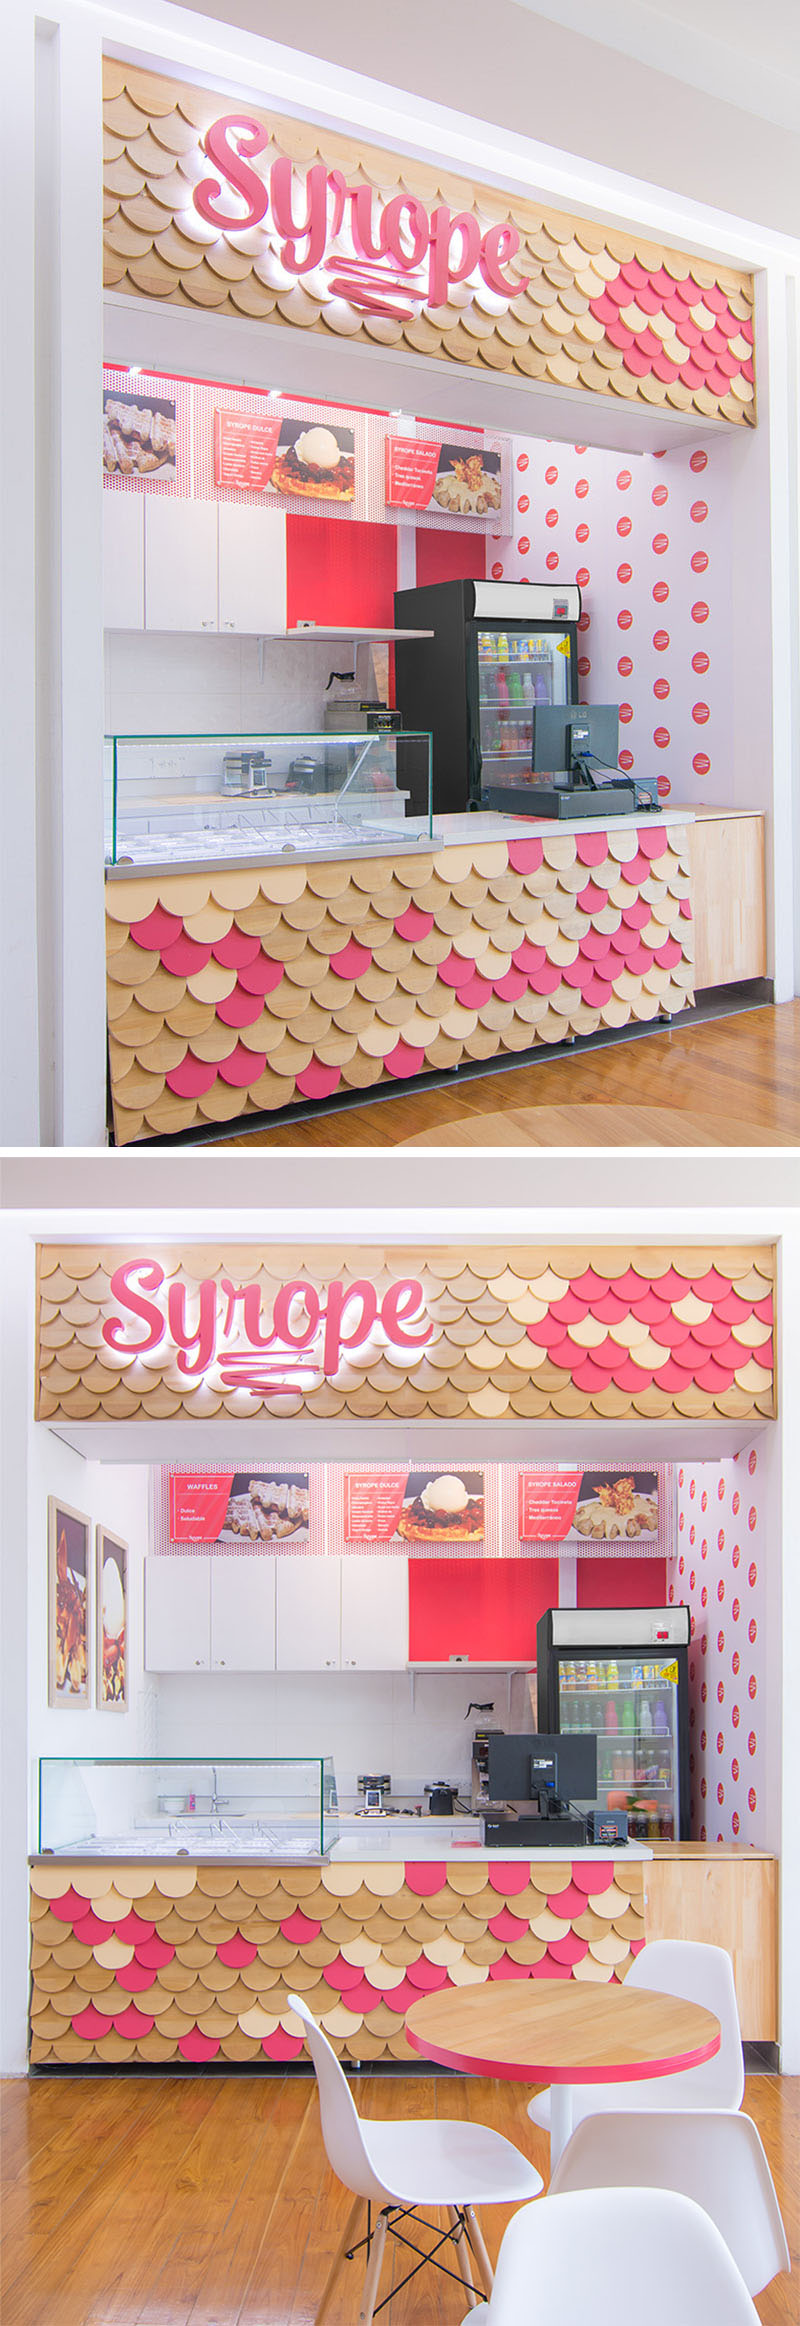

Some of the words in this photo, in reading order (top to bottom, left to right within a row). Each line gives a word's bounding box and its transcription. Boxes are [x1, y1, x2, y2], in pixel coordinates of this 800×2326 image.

[193, 114, 530, 308] Syrope
[226, 421, 251, 431] SYROPE
[252, 424, 273, 434] DULCE
[394, 446, 415, 455] SYROPE
[415, 449, 437, 458] SALADO
[102, 1258, 433, 1376] Syrope
